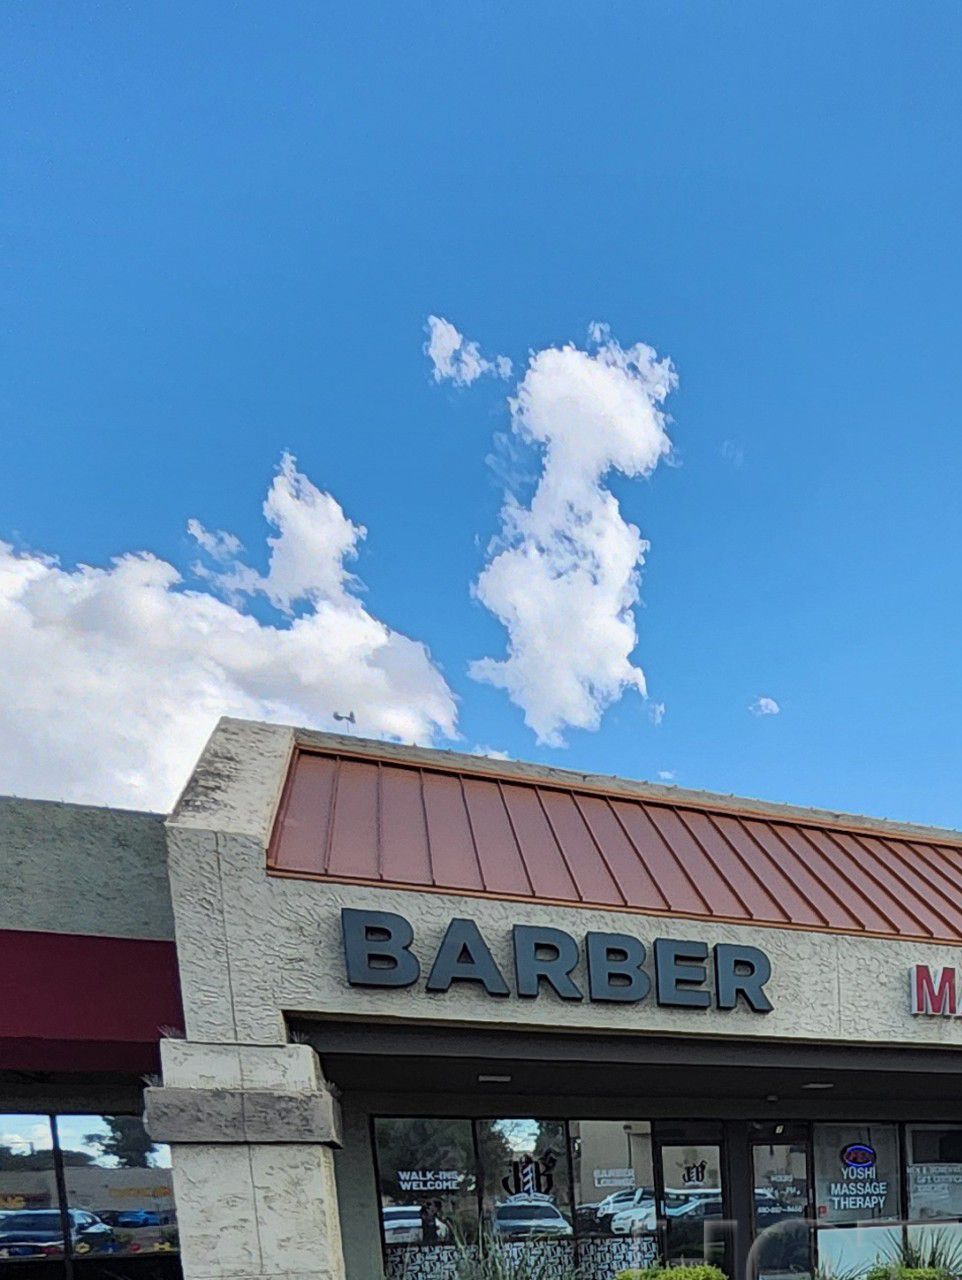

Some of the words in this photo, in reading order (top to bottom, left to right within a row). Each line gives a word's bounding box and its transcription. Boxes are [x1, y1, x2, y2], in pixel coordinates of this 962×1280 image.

[341, 907, 774, 1013] BARBER
[841, 1166, 876, 1180] YOSHI
[399, 1181, 461, 1191] WELCOME
[830, 1182, 887, 1196] MASSAGE
[831, 1196, 886, 1209] THERAPY
